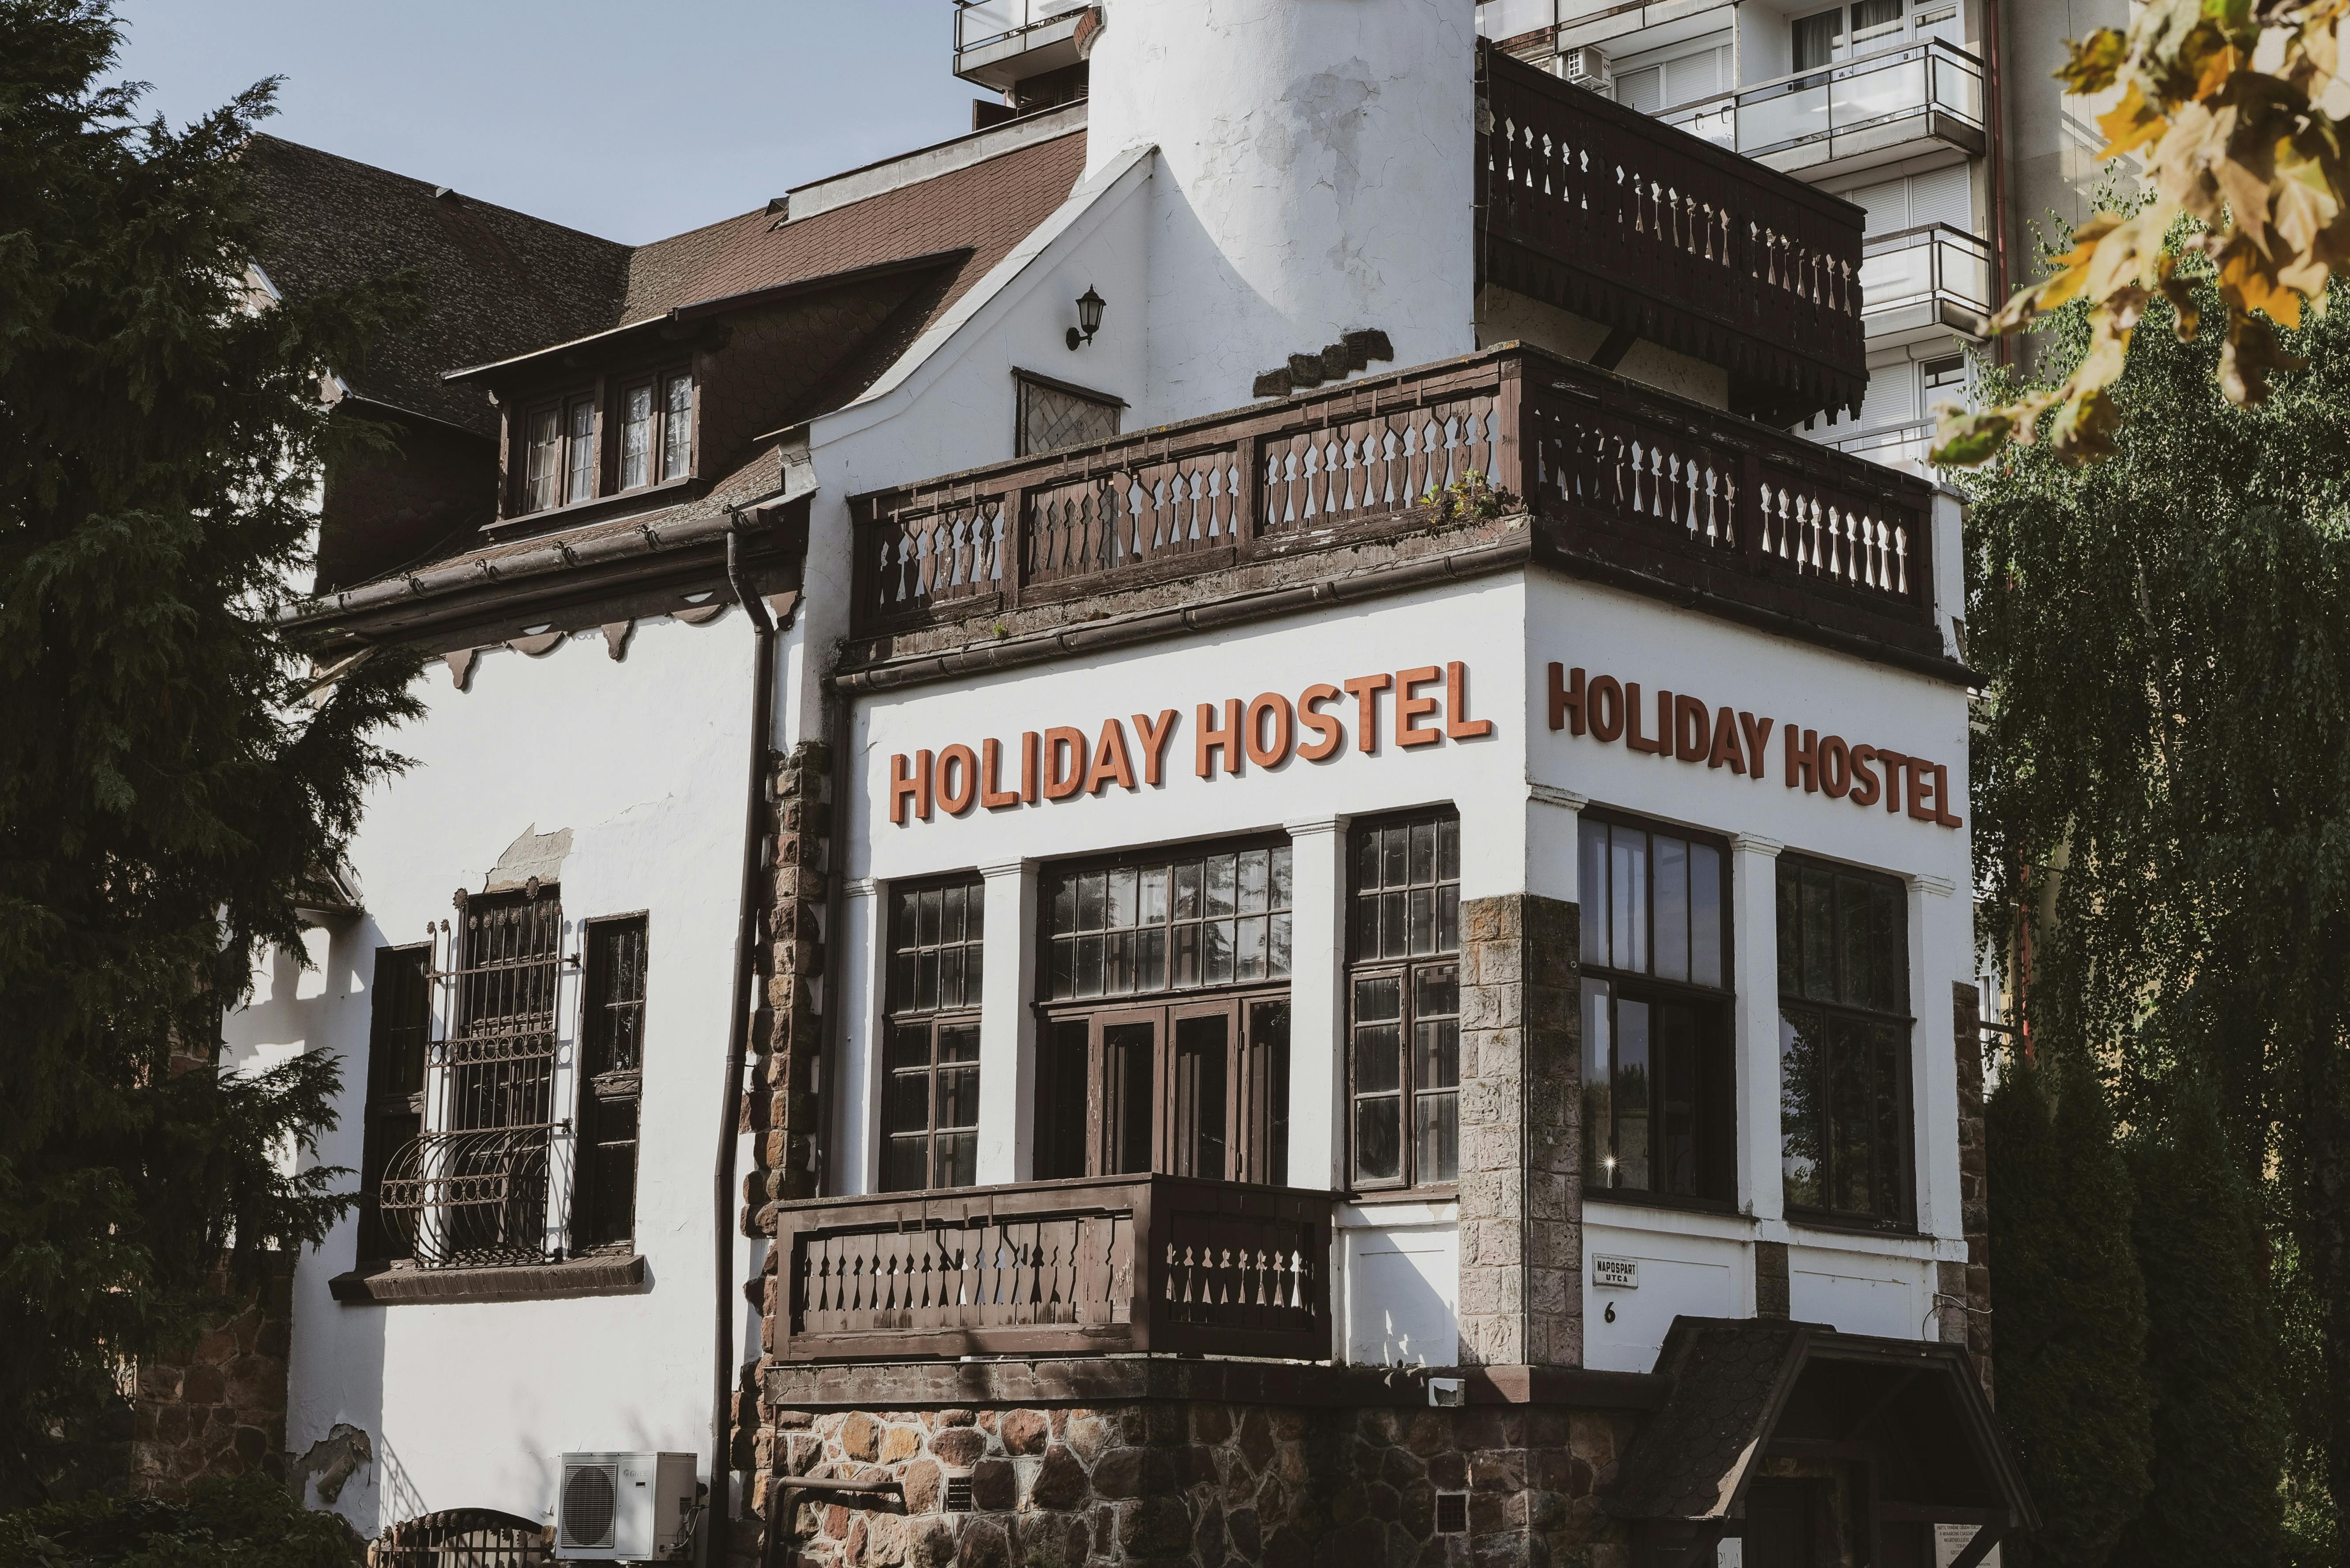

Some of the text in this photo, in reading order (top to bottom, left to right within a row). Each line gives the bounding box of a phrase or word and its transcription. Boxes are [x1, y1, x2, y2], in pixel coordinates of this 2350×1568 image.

[890, 661, 1492, 823] HOLIDAY HOSTEL
[1548, 661, 1963, 829] HOLIDAY HOSTEL
[1597, 1260, 1635, 1275] NAPOSPART
[1604, 1302, 1616, 1324] 6
